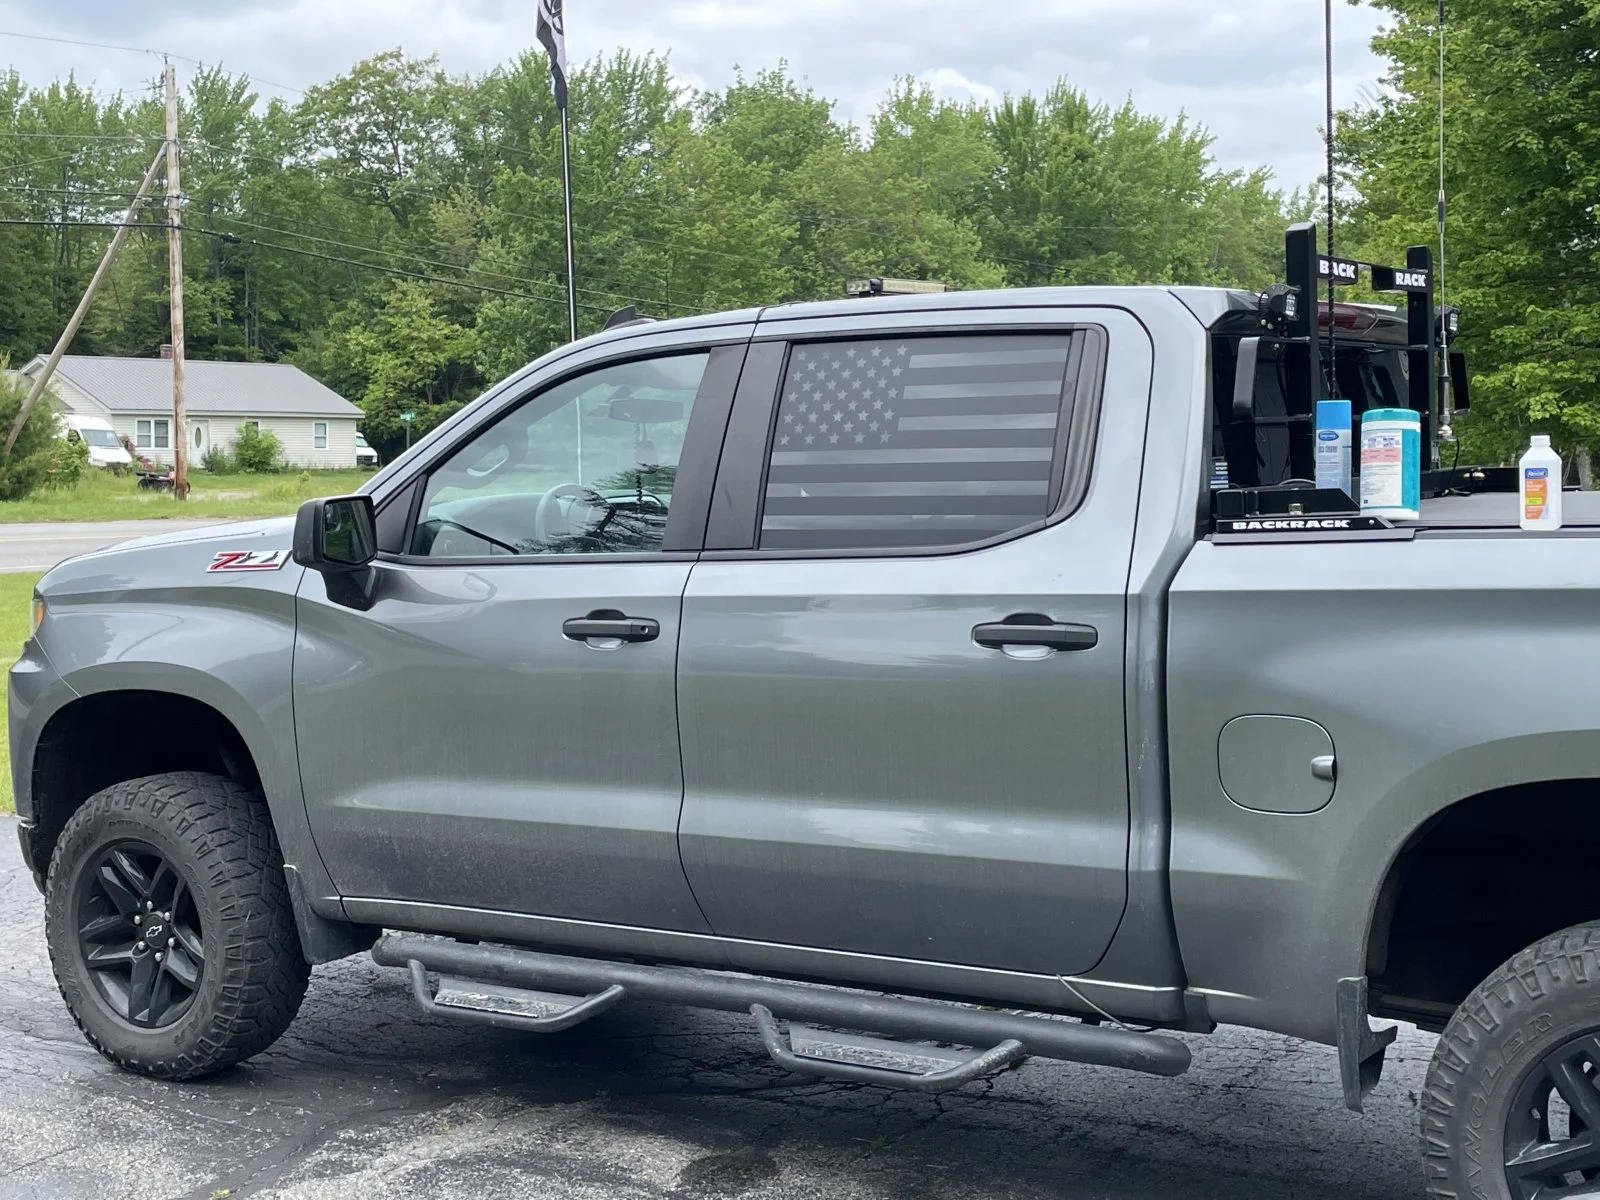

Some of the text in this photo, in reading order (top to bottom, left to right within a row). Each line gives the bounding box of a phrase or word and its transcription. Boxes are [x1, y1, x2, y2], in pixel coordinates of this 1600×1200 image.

[1395, 271, 1426, 287] RACK
[1232, 519, 1351, 530] BACKRACK
[206, 549, 294, 573] Z71
